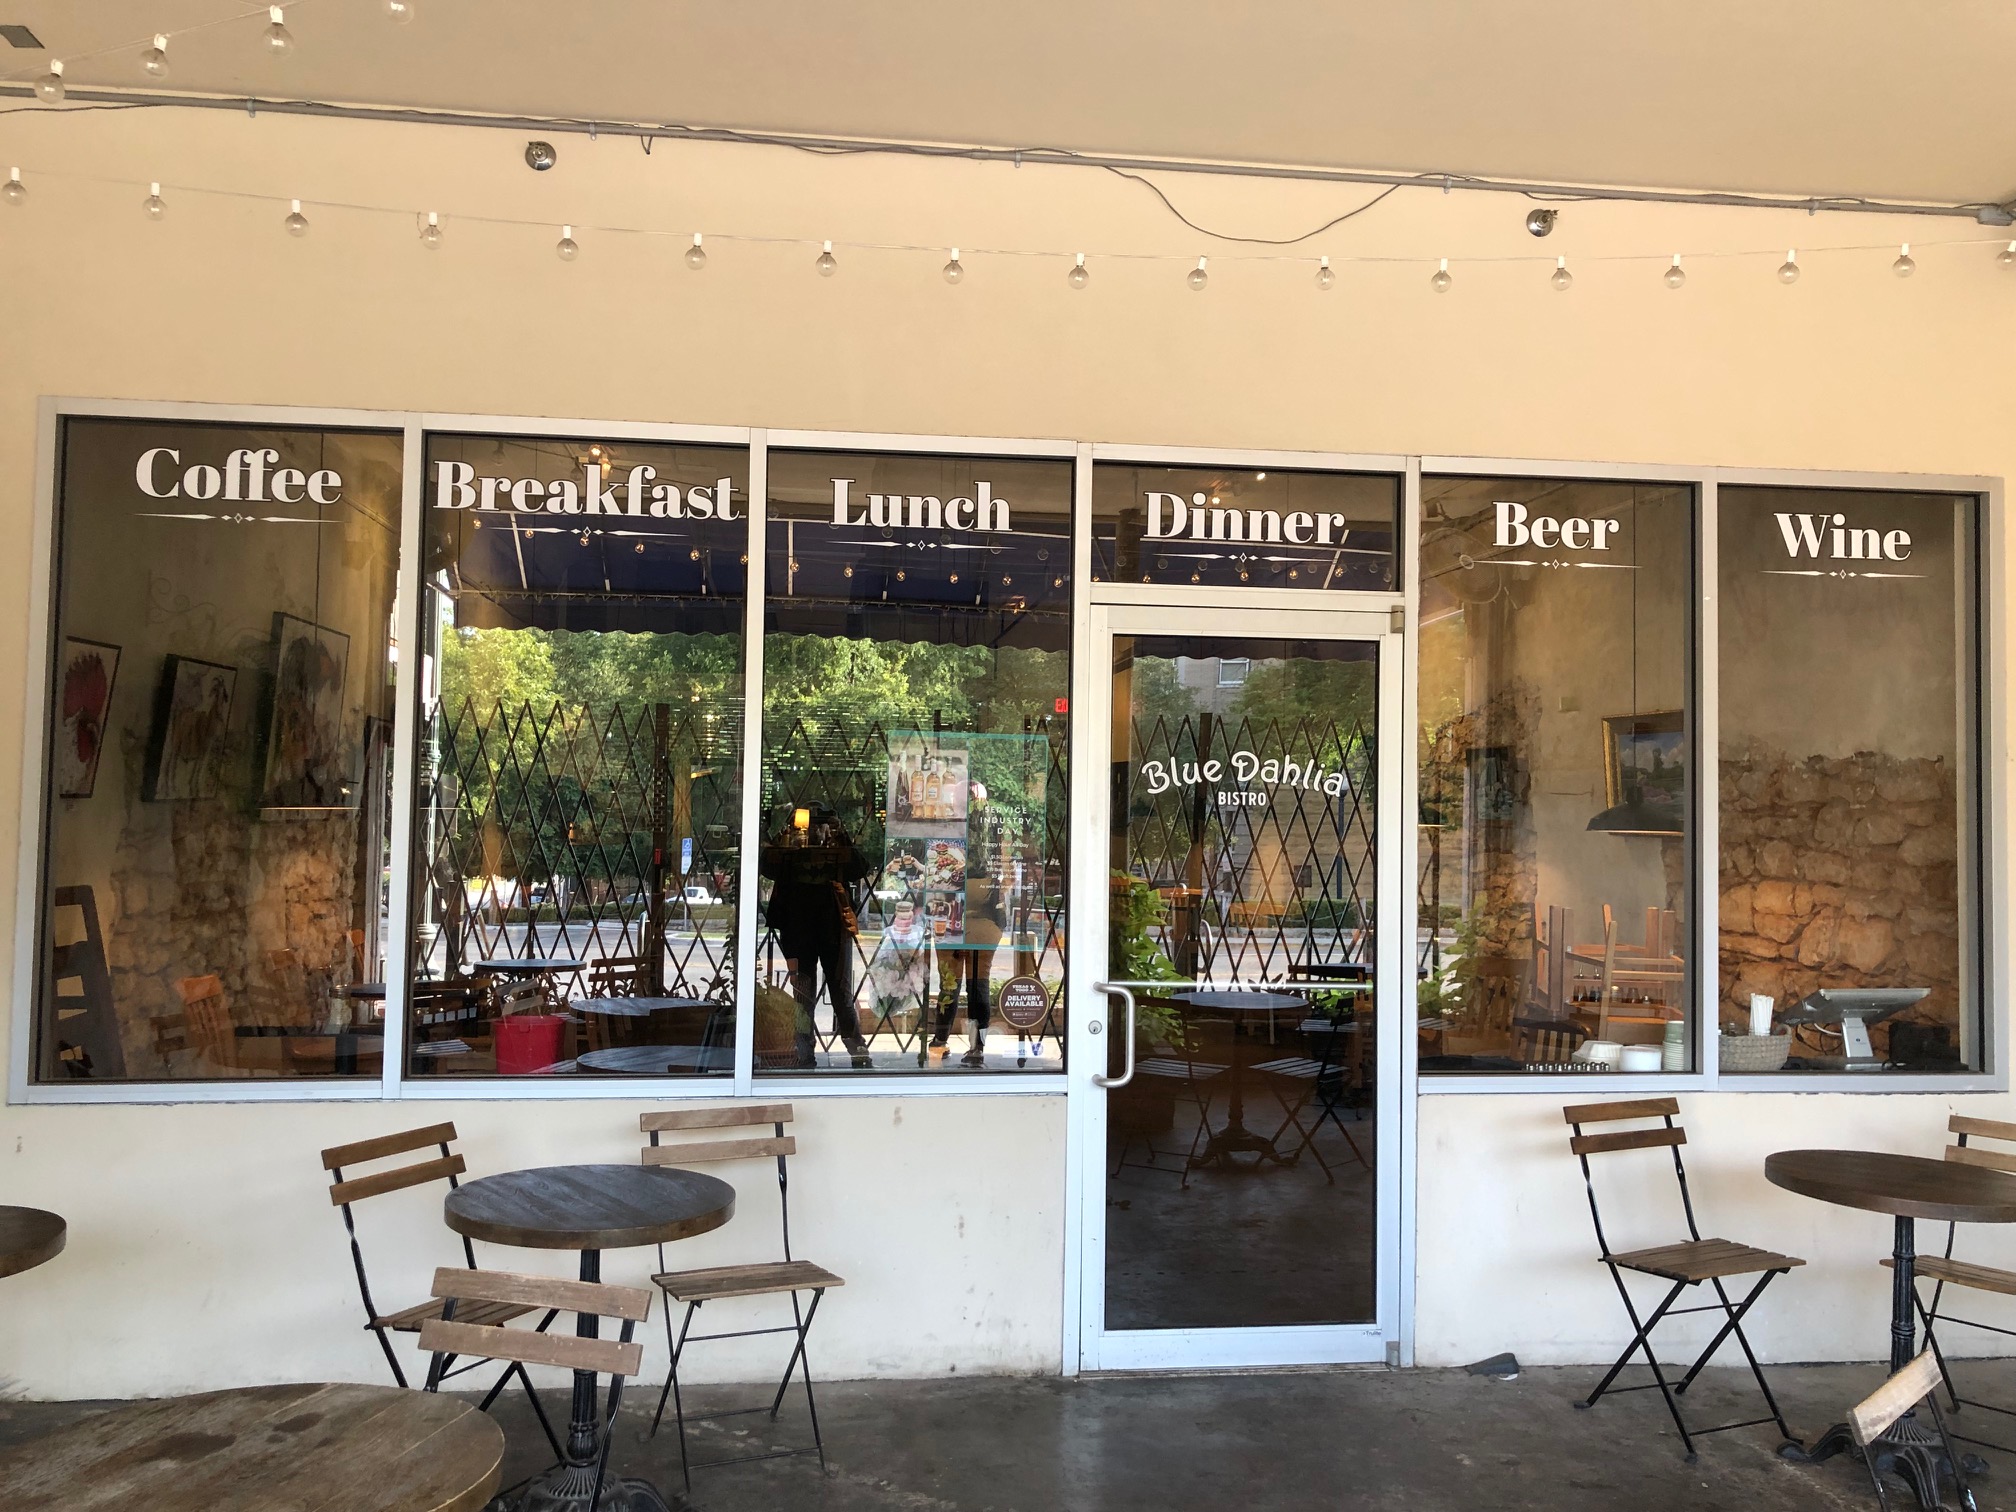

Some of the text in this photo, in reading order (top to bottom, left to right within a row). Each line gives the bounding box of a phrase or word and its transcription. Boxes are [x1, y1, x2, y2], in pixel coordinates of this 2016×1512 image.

[135, 448, 342, 504] Coffee
[433, 461, 741, 522] Breakfast
[830, 478, 1013, 531] Lunch
[1143, 491, 1345, 545] Dinner
[1492, 501, 1620, 550] Beer
[1773, 512, 1912, 561] Wine
[1142, 750, 1344, 798] Blue Dahlia
[1218, 791, 1267, 806] BISTRO
[980, 816, 1032, 825] INDUSTRY
[984, 806, 1028, 814] SERVICE
[997, 827, 1018, 835] DAY
